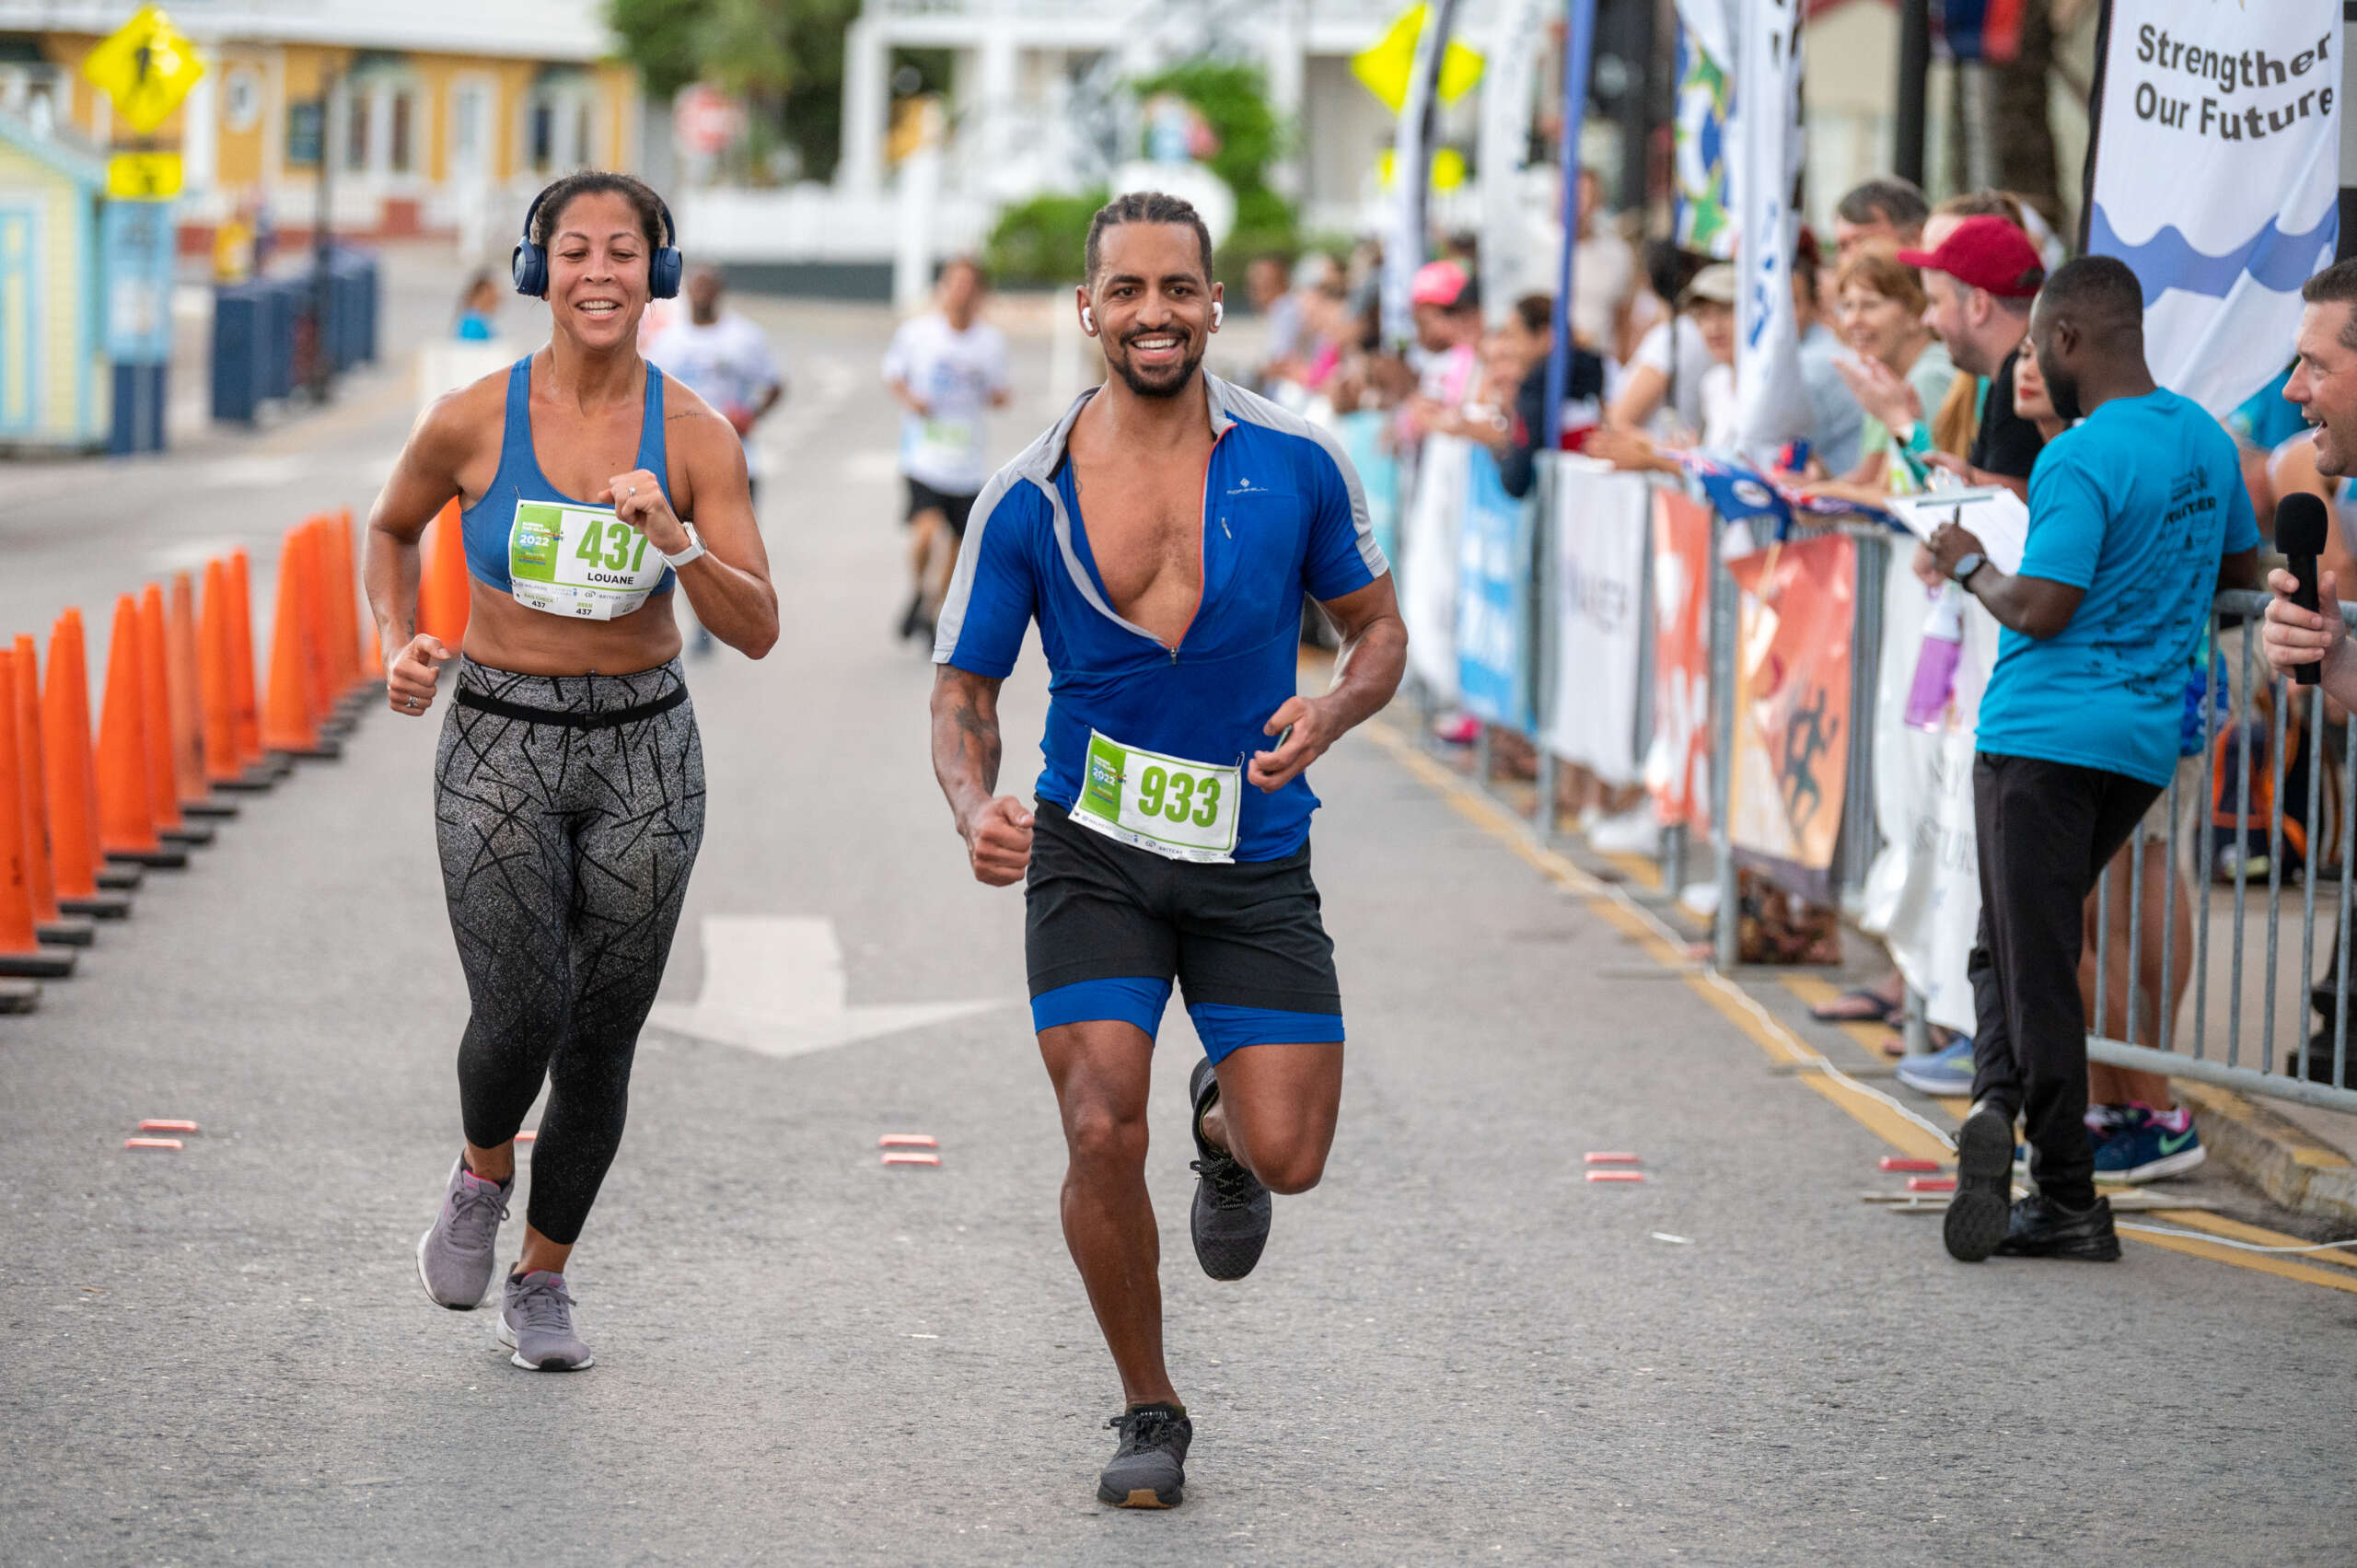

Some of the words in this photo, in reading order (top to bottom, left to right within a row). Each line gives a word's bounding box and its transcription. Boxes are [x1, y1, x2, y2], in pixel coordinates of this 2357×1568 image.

[2135, 82, 2189, 130] Our
[2200, 87, 2333, 140] Future
[519, 534, 550, 547] 2022
[575, 520, 649, 573] 437
[587, 573, 634, 585] LOUANE
[531, 600, 546, 609] 437
[1092, 767, 1116, 787] 2022
[1138, 765, 1221, 828] 933
